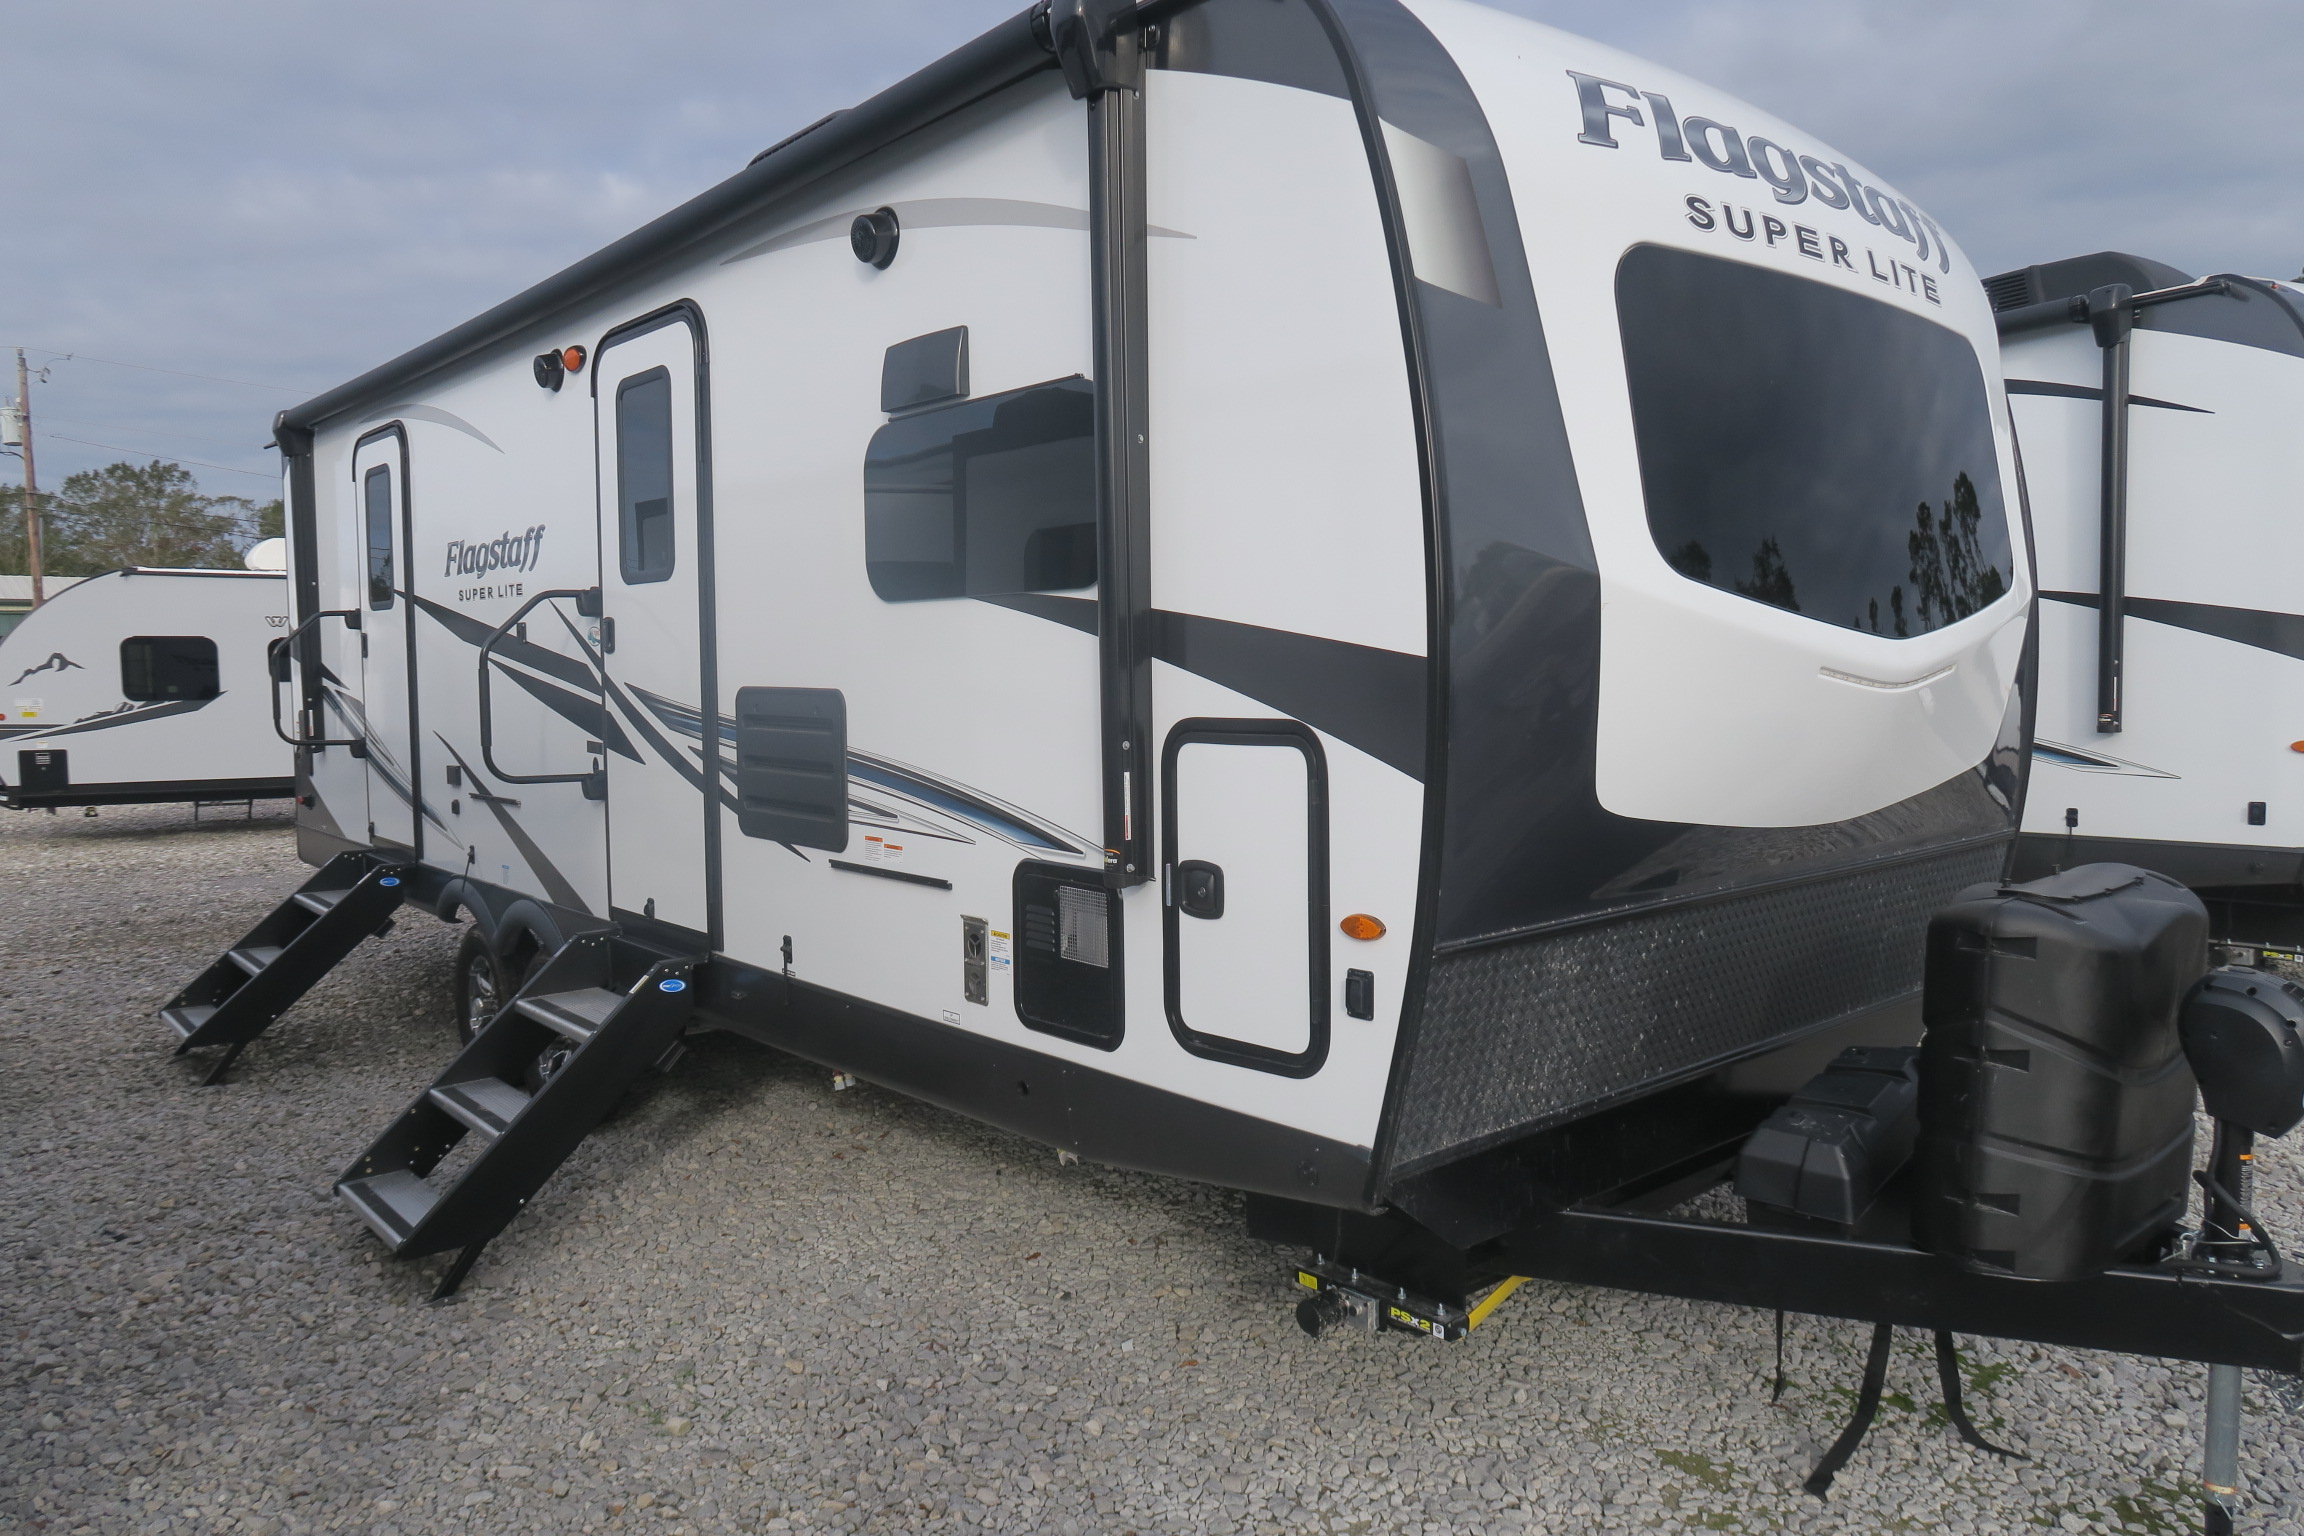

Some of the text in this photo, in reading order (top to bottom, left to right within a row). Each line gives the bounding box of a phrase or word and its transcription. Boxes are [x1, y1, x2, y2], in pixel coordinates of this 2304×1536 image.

[1566, 69, 1951, 275] Flagstaff
[1685, 194, 1941, 306] SUPER LITE
[444, 524, 546, 579] Flagstaff
[458, 584, 524, 601] SUPER LITE
